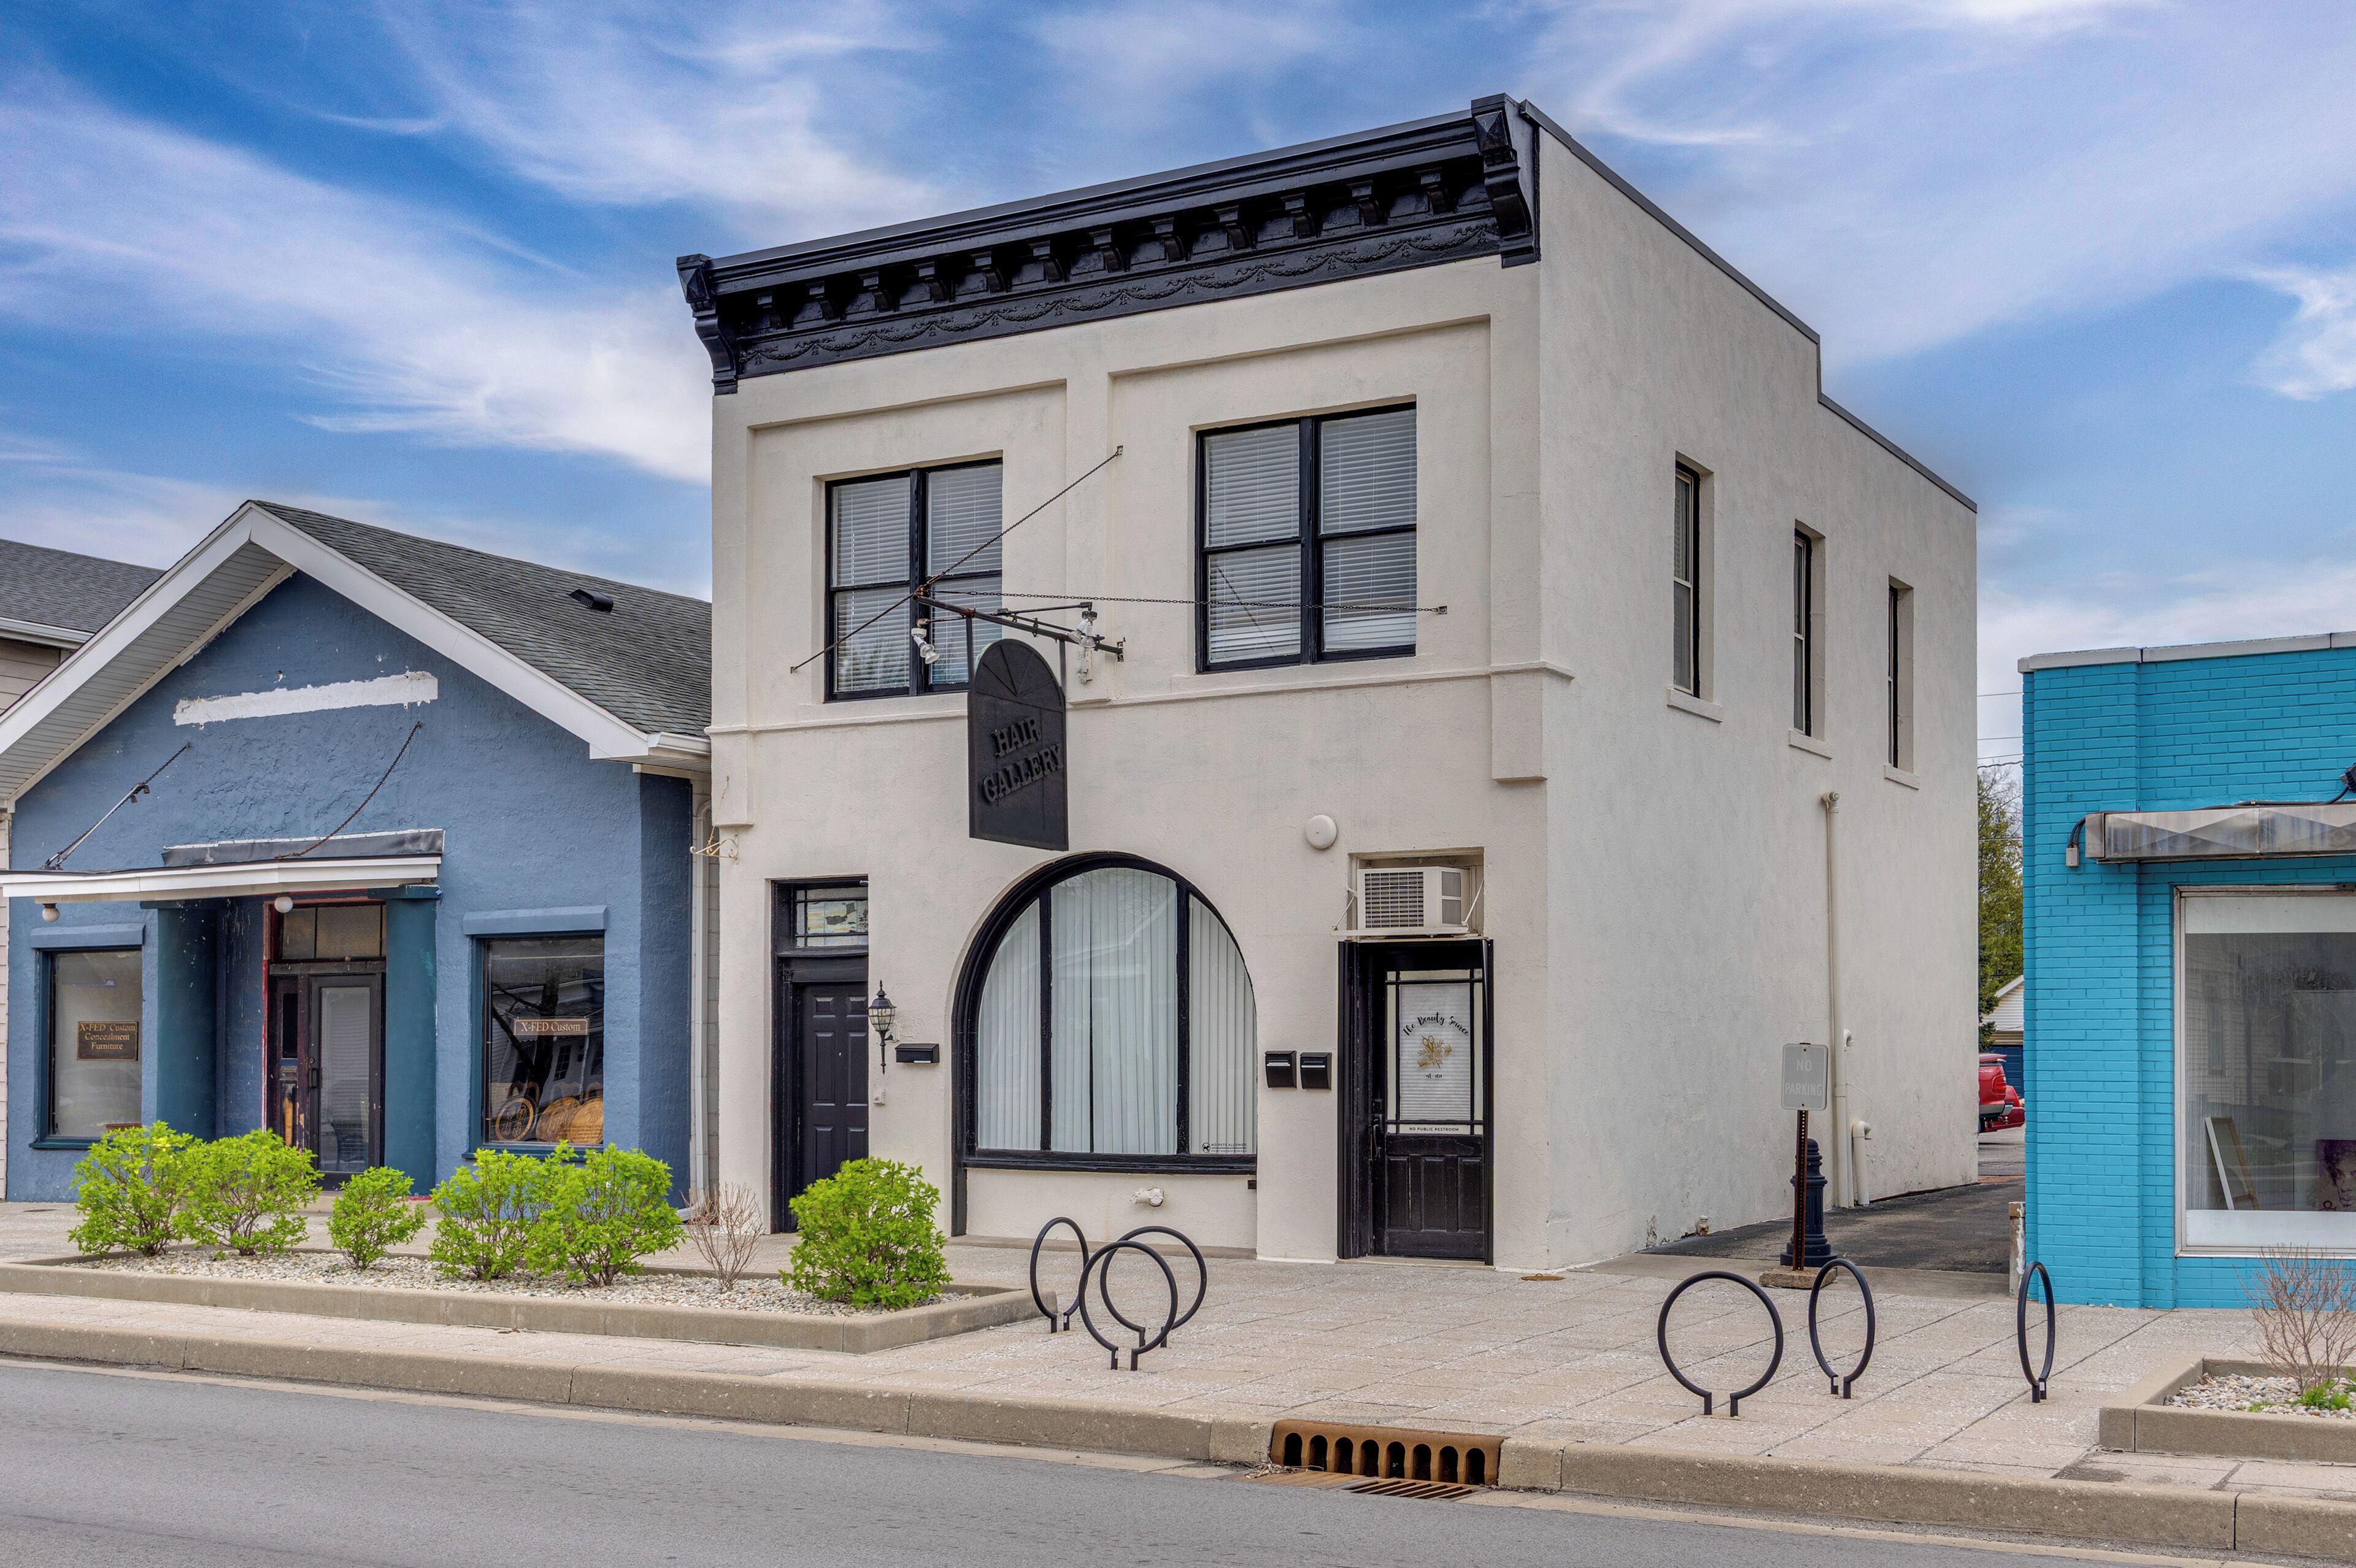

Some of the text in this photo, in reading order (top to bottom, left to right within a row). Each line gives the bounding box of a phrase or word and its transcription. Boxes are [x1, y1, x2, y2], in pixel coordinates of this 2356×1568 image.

[991, 716, 1042, 758] HAIR
[983, 742, 1064, 802] GALLERY
[521, 1021, 580, 1032] X-FED Custom
[1403, 1012, 1469, 1036] The Beauty Source
[85, 1032, 130, 1041] Concealment
[1796, 1059, 1812, 1072] NO
[1785, 1082, 1822, 1096] PARKING
